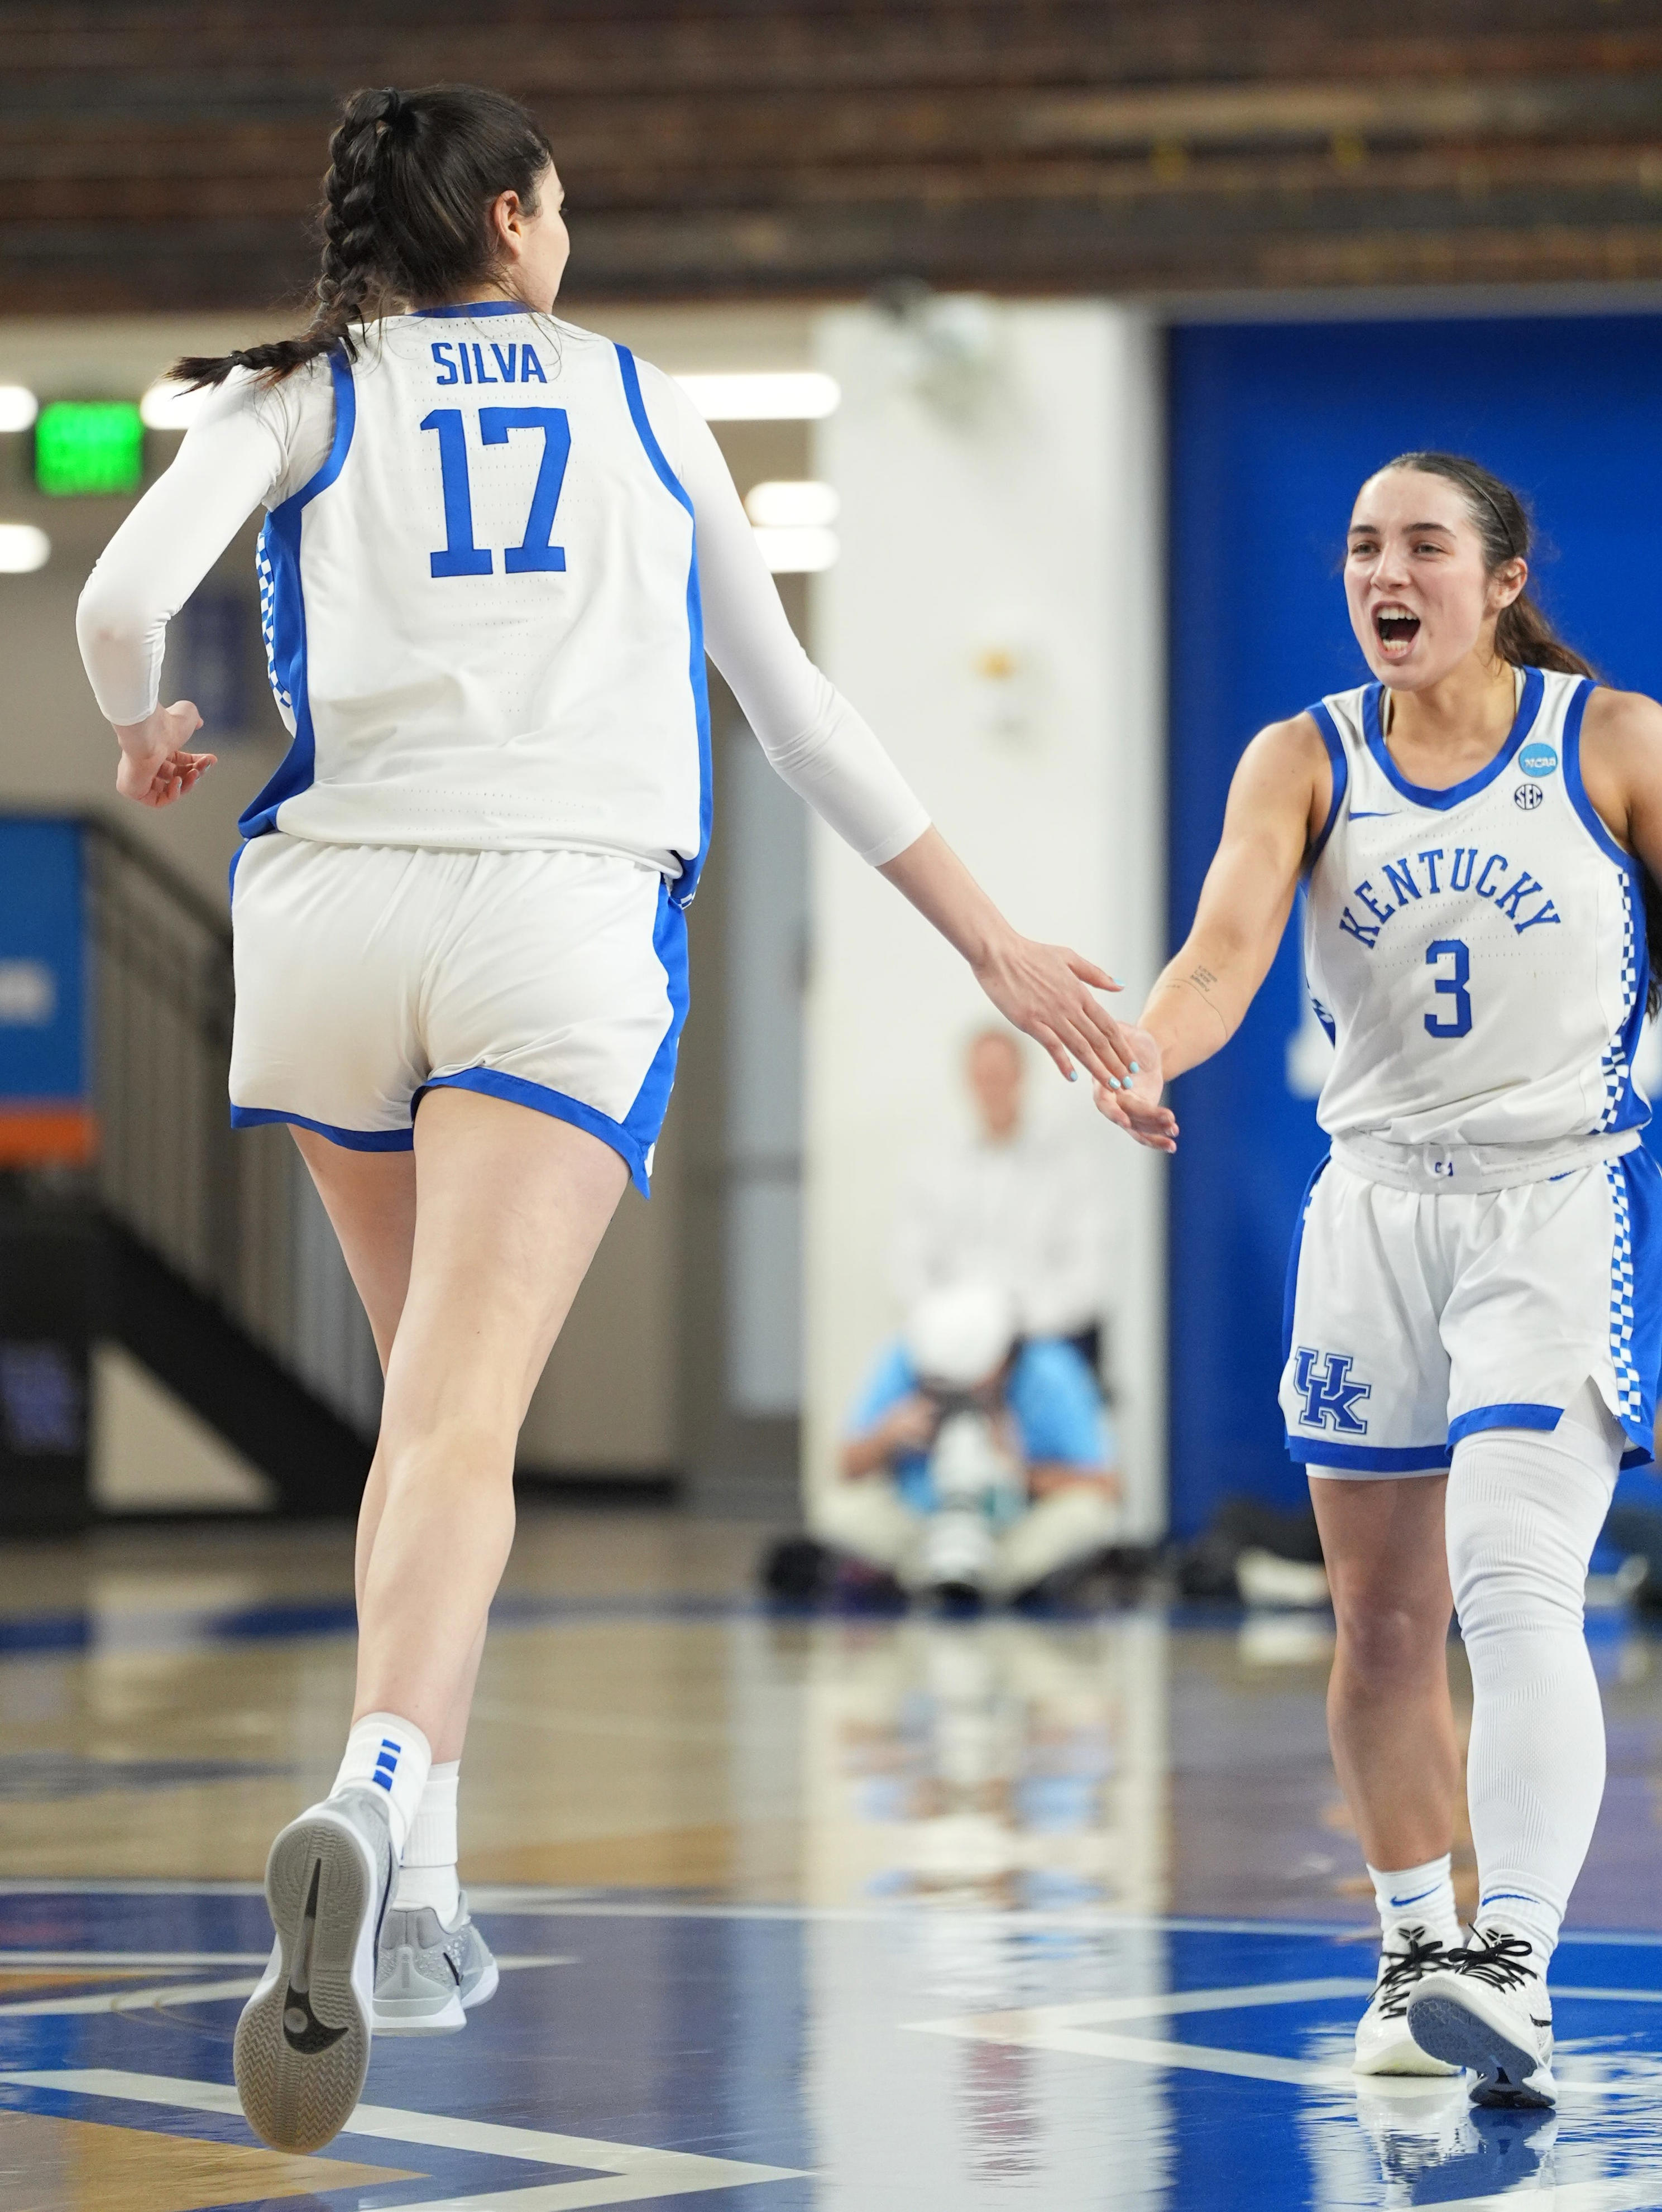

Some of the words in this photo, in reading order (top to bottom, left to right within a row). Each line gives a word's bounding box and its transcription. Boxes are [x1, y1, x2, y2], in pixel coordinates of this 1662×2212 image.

[431, 343, 548, 385] SILVA
[420, 407, 571, 577] 17
[1515, 784, 1543, 810] SEC
[1524, 757, 1556, 768] NCAA
[1339, 849, 1561, 949] KENTUCKY
[1424, 940, 1472, 1038] 3
[1294, 1347, 1371, 1434] UK
